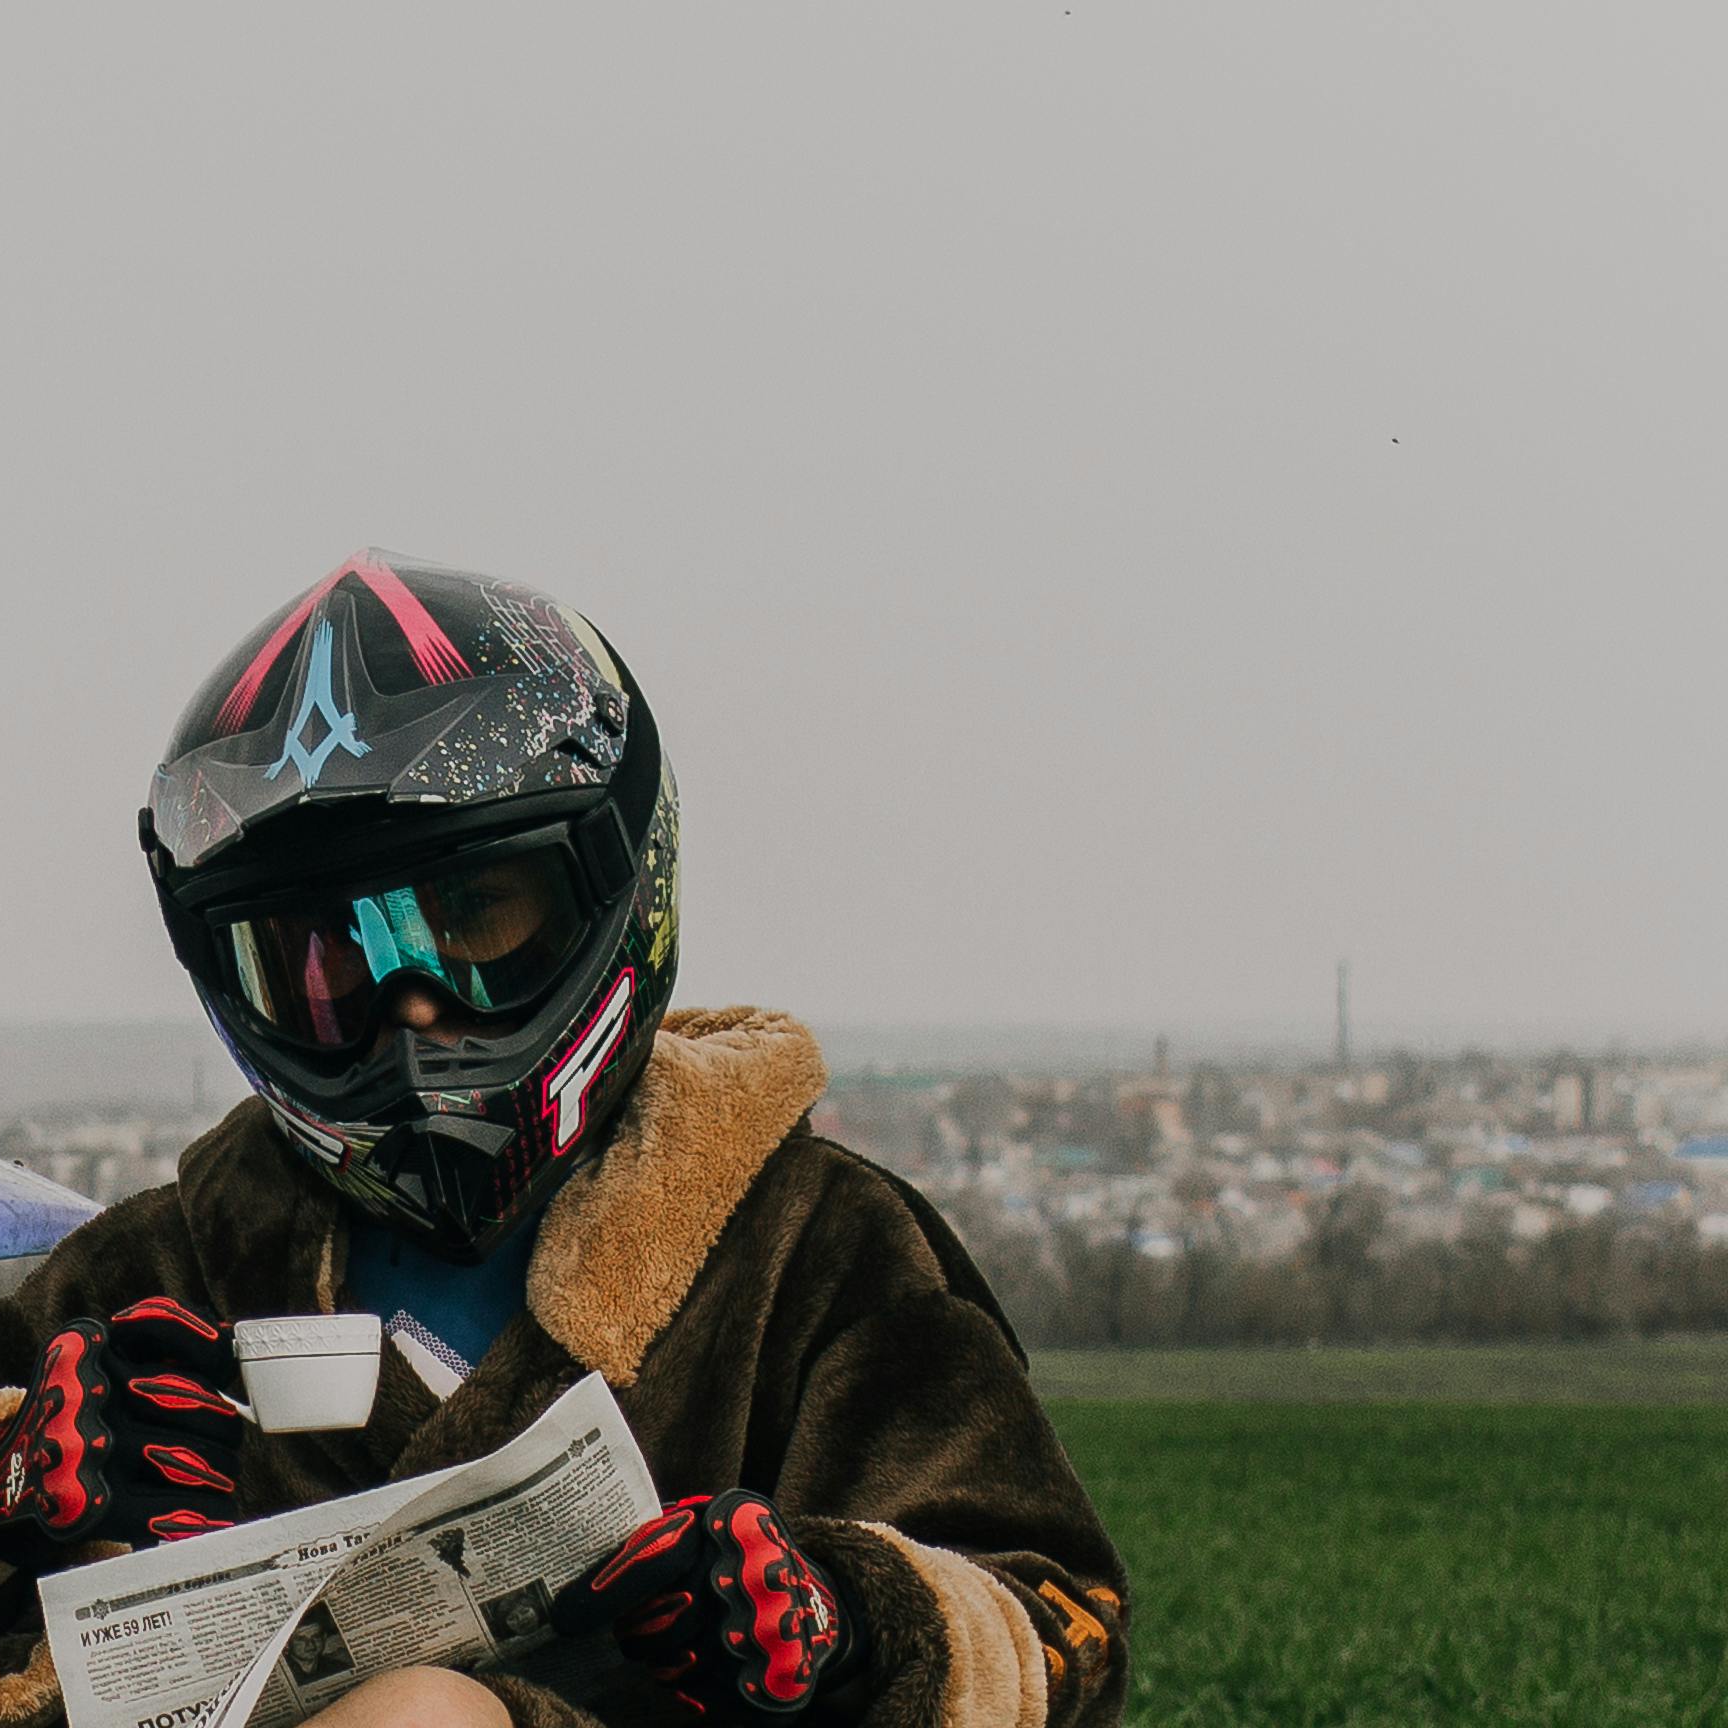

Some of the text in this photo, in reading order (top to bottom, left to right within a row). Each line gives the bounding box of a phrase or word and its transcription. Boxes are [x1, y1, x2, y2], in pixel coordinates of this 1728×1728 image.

[80, 1610, 173, 1647] И УЖЕ 59 ЛЕТ!
